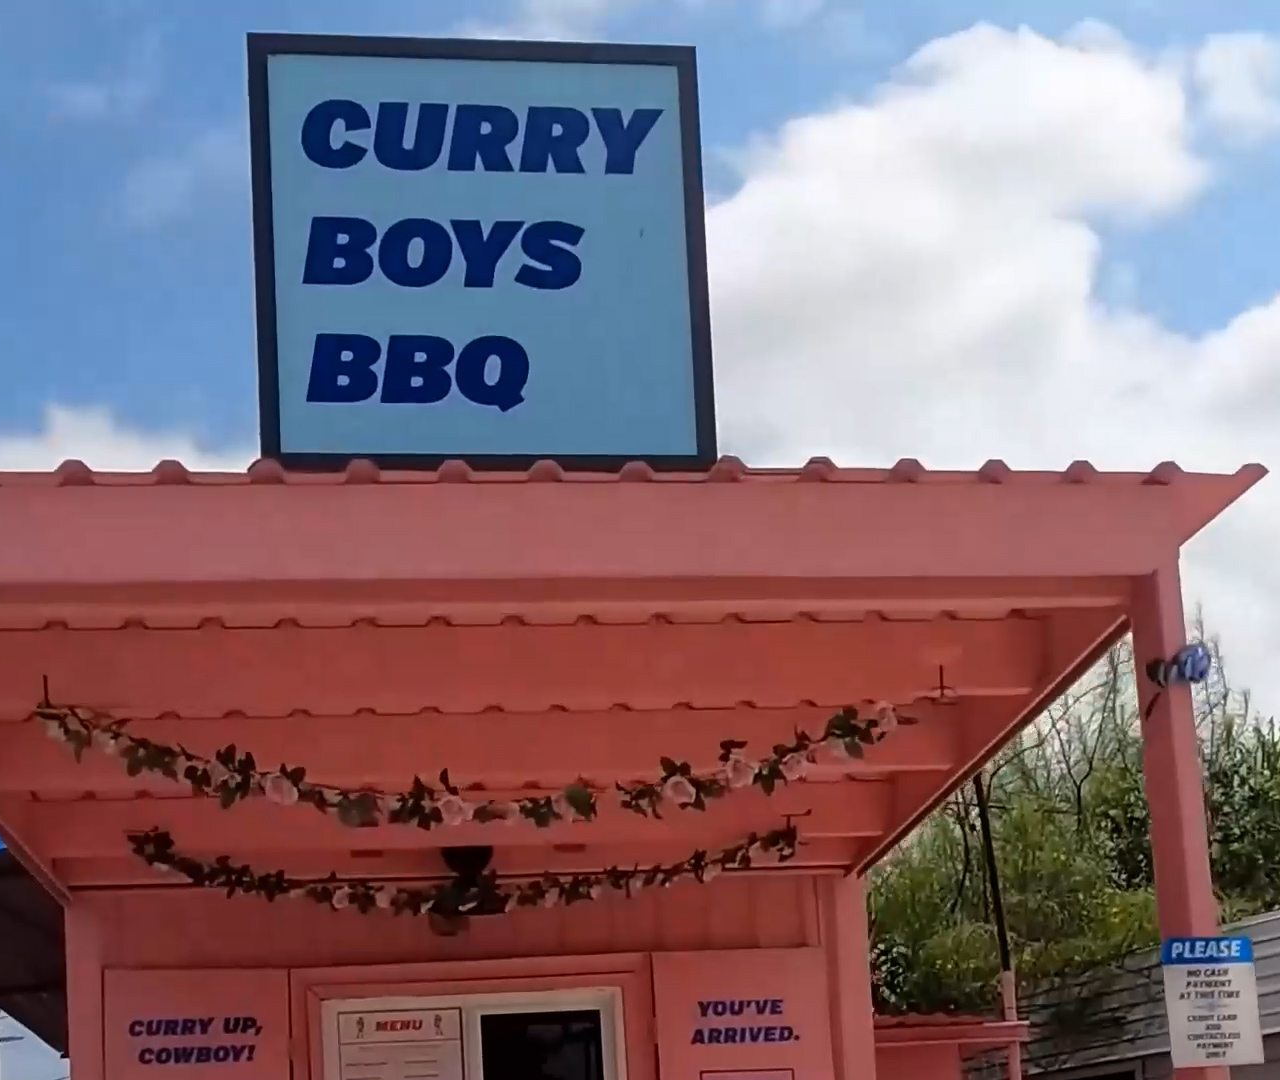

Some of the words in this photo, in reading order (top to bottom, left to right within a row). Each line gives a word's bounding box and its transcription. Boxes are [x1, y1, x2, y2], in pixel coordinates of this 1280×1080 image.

[301, 99, 664, 174] CURRY
[302, 216, 585, 289] BOYS
[306, 333, 530, 412] BBQ
[1171, 940, 1242, 959] PLEASE
[1204, 968, 1229, 977] CASH
[1185, 979, 1232, 989] PAYMENT
[697, 999, 784, 1017] YOU'VE
[128, 1017, 215, 1037] CURRY
[223, 1016, 262, 1037] UP,
[374, 1019, 424, 1032] MENU
[690, 1026, 800, 1045] ARRIVED.
[138, 1045, 255, 1065] COWBOY!
